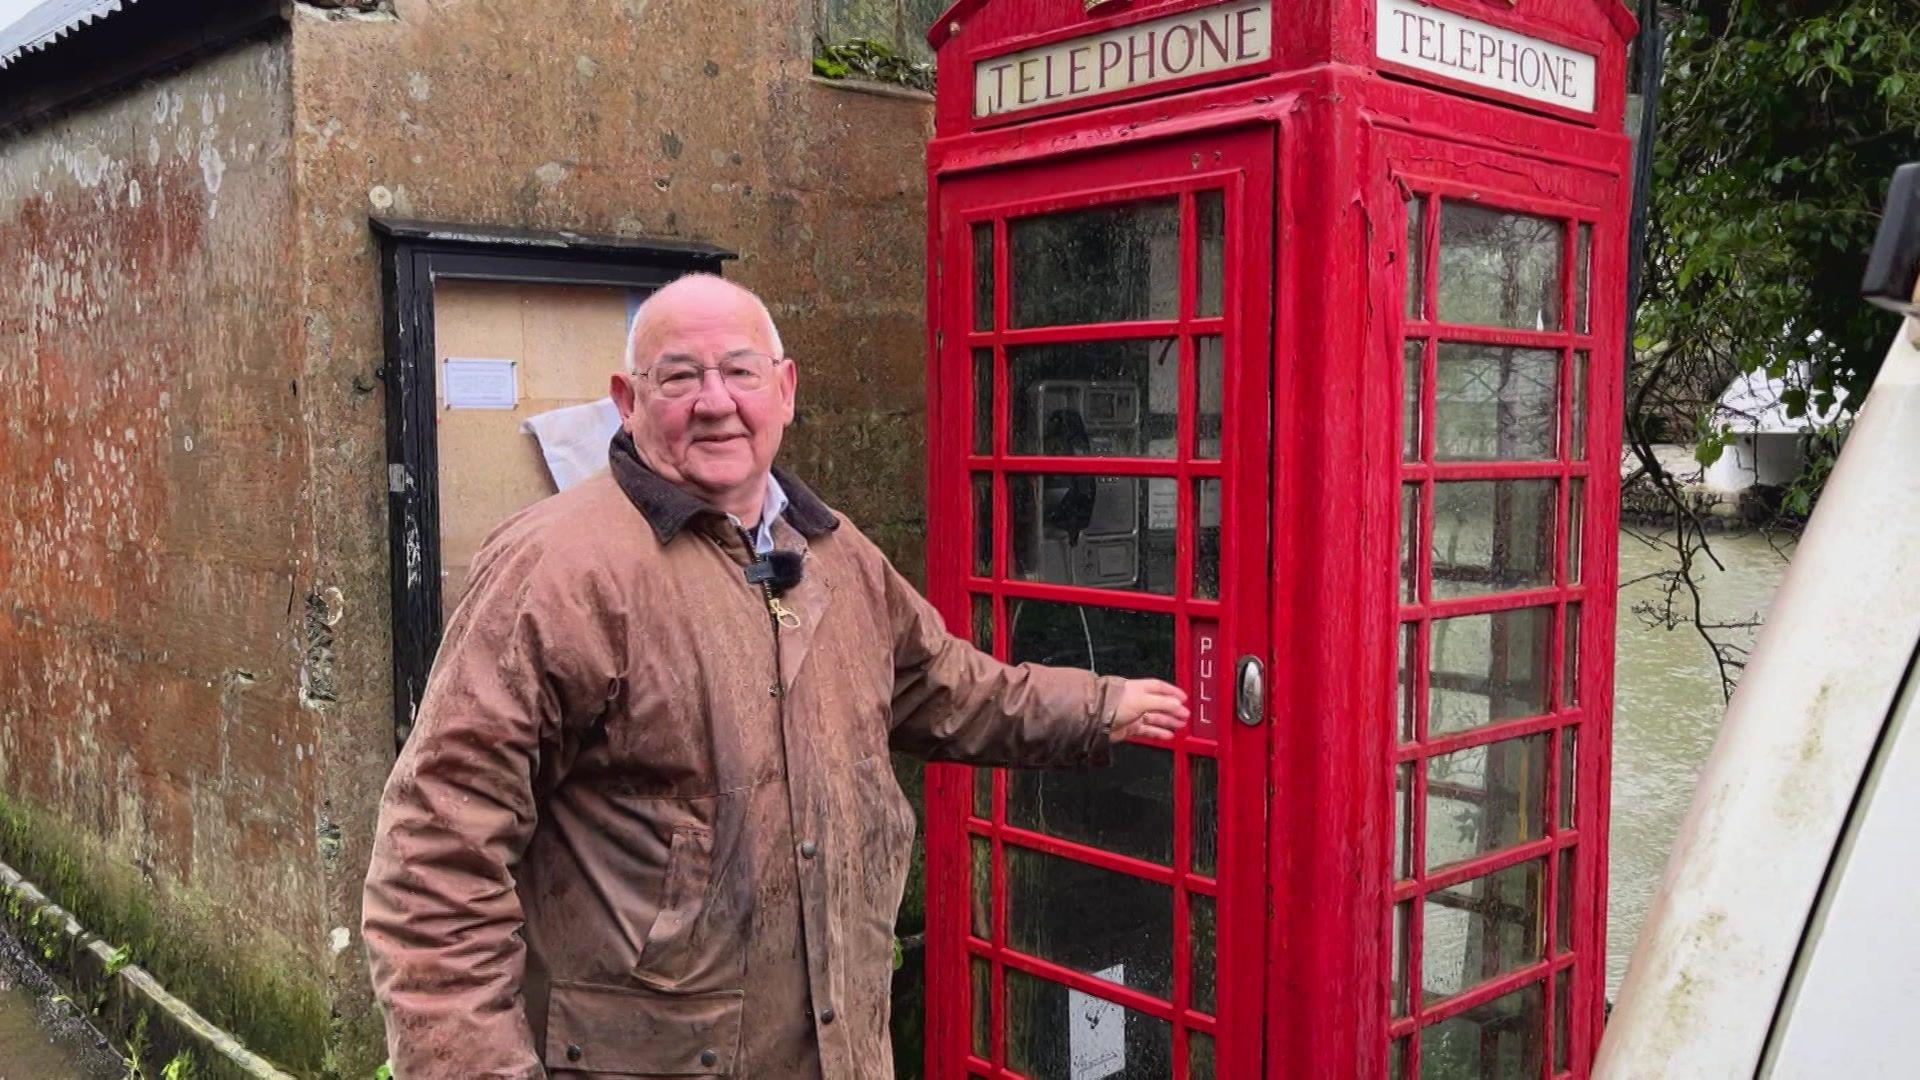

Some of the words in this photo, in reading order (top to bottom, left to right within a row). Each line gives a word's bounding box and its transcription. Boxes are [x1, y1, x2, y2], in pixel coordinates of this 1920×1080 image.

[989, 7, 1261, 108] TELEPHONE
[1393, 9, 1577, 98] TELEPHONE
[1200, 636, 1212, 724] PULL
